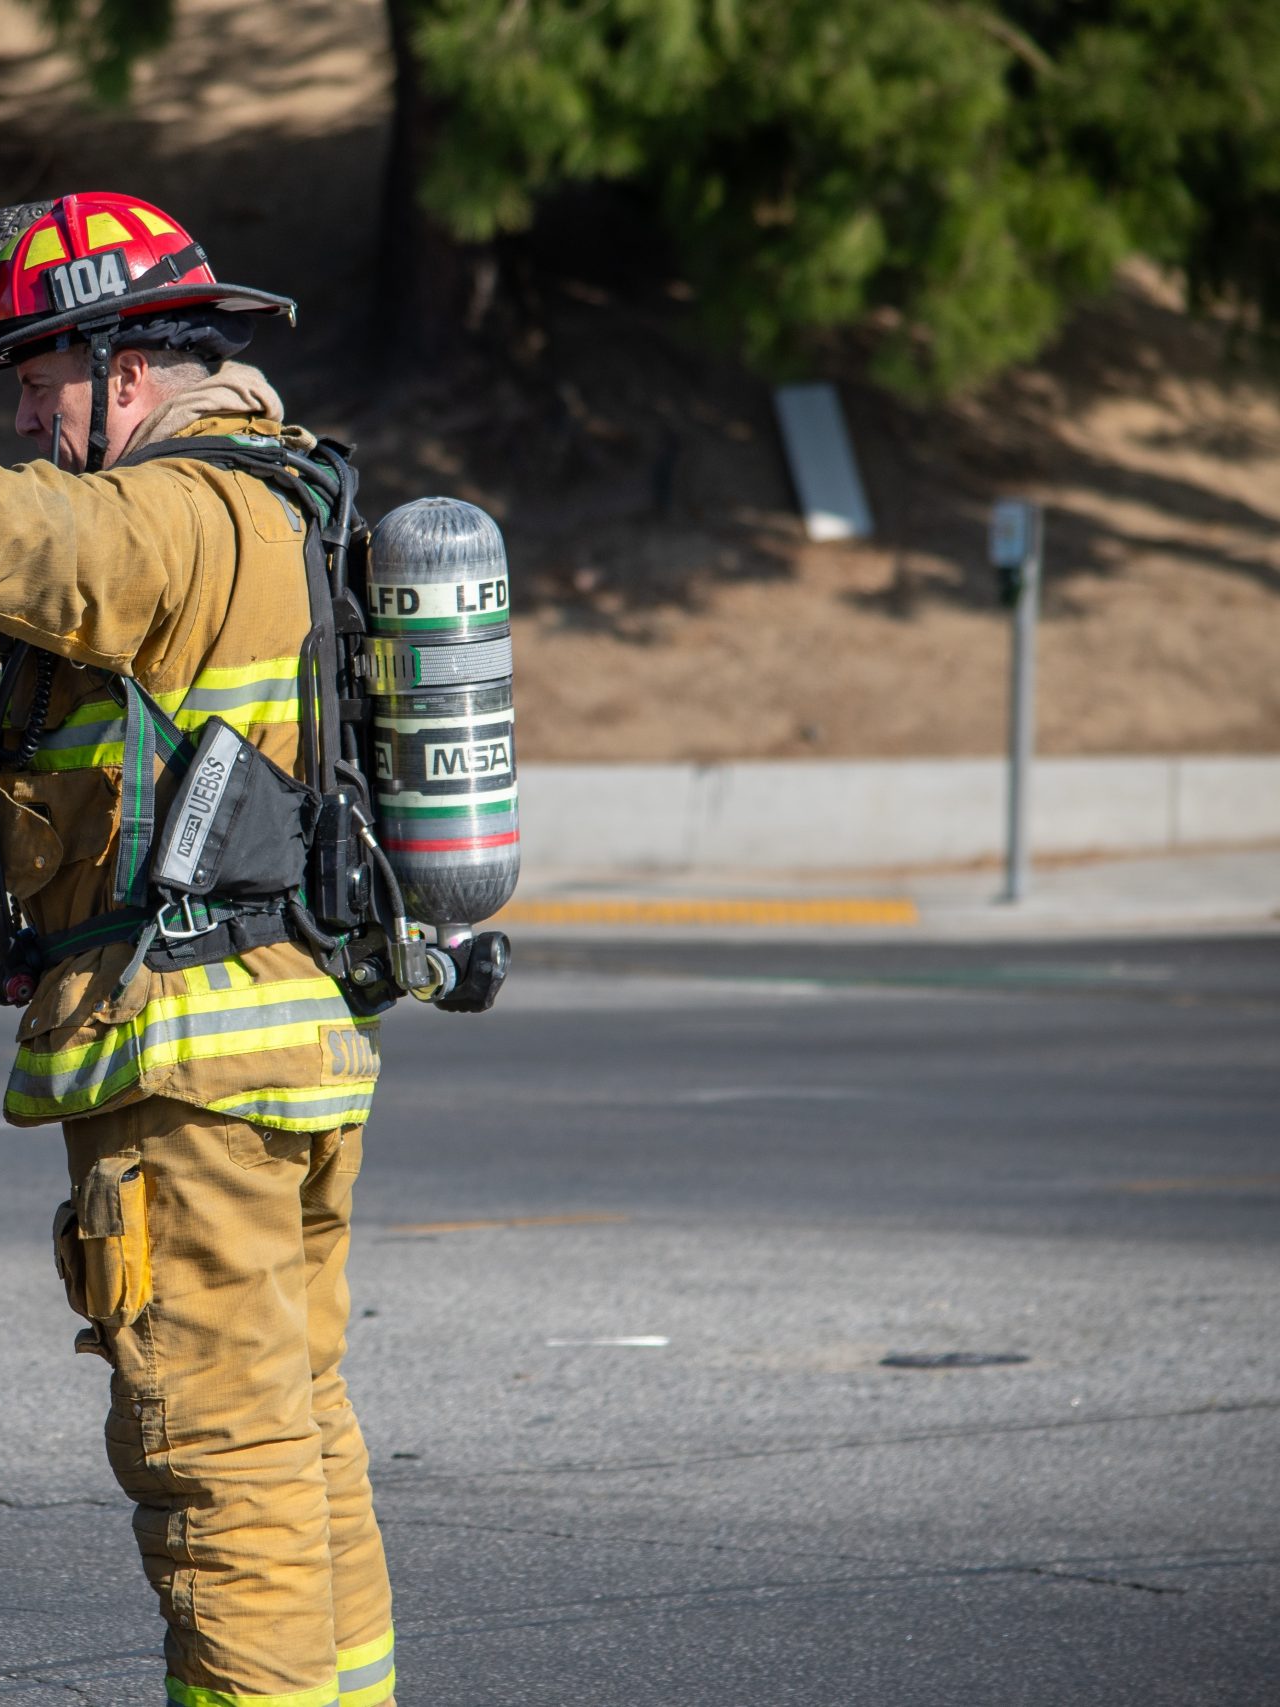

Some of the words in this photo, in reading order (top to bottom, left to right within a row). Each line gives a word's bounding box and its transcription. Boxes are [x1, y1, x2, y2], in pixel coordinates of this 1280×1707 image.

[53, 253, 127, 310] 104
[368, 585, 420, 615] LFD
[456, 579, 507, 613] LFD
[432, 742, 509, 776] MSA
[188, 756, 226, 815] UEBSS
[177, 814, 202, 858] MSA
